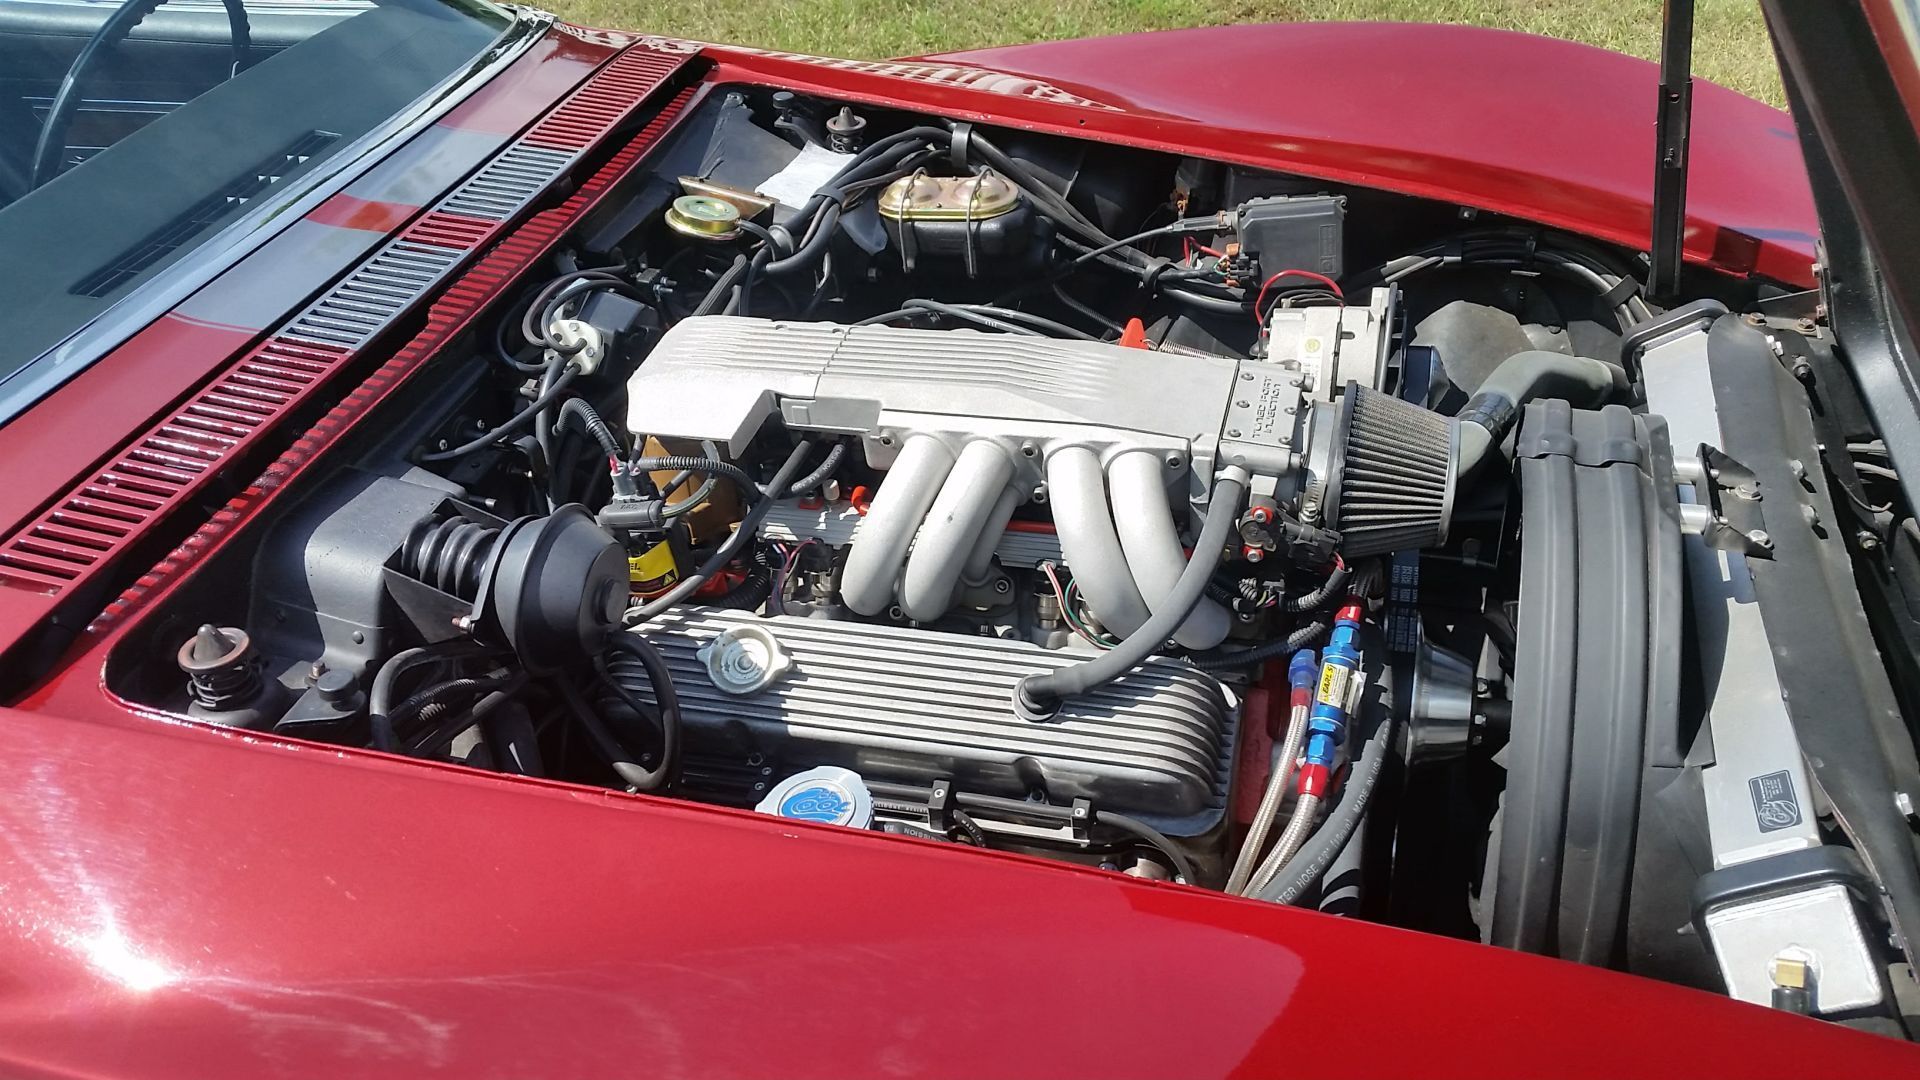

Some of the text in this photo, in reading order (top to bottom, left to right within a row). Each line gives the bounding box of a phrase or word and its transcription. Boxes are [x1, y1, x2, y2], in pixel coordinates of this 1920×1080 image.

[1252, 376, 1272, 438] TUNED PORT
[1264, 383, 1281, 434] INJECTION
[1275, 886, 1297, 906] ATER
[1296, 864, 1319, 888] HOSE
[1352, 790, 1369, 814] MADE
[1366, 777, 1376, 790] IN
[1372, 757, 1384, 776] USA
